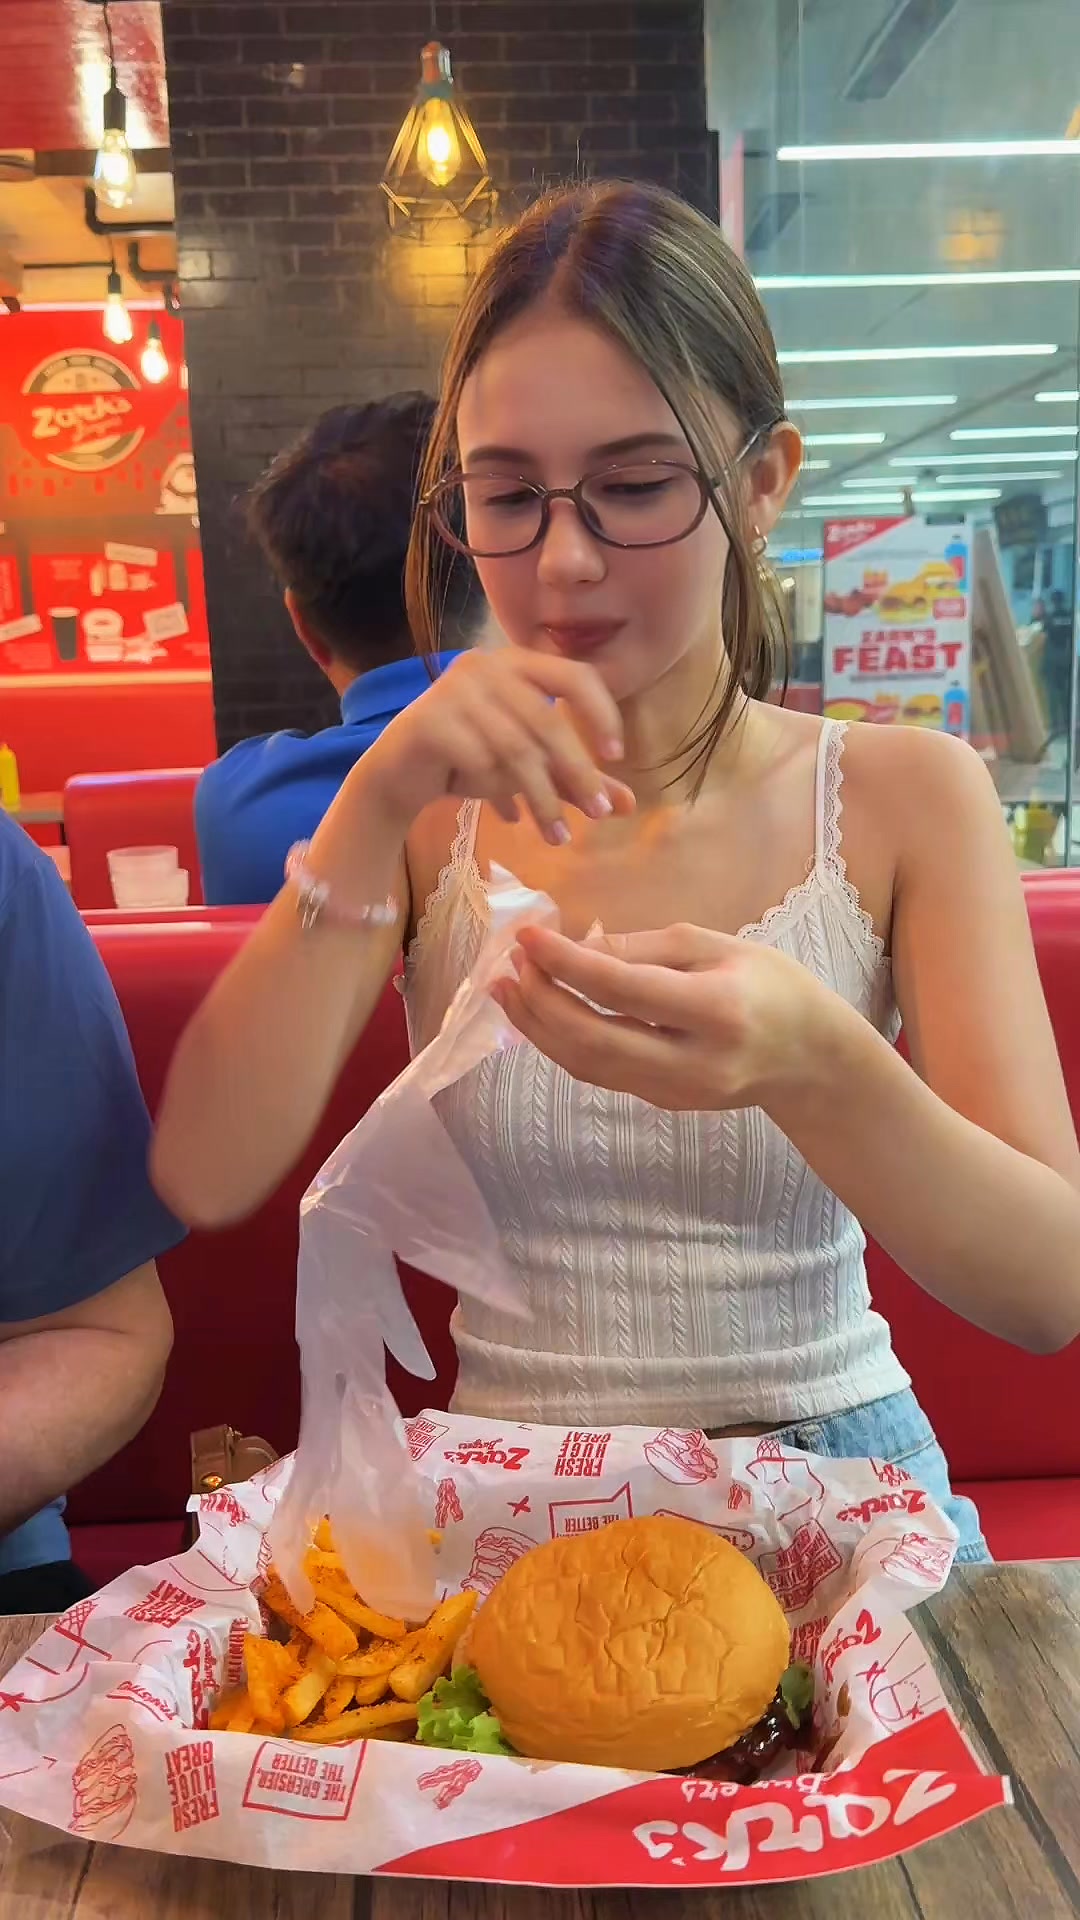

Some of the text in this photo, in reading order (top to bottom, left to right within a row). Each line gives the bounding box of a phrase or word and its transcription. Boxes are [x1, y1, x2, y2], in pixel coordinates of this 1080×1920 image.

[833, 642, 963, 674] FEAST
[558, 1442, 608, 1459] HUGE
[562, 1431, 612, 1443] GREAT
[444, 1447, 530, 1471] Zark's
[553, 1457, 603, 1477] FRESH
[564, 1515, 600, 1533] BETTER
[164, 1741, 214, 1780] GREAT
[271, 1753, 345, 1782] THE BETTER
[166, 1765, 217, 1806] HUGE
[256, 1767, 346, 1802] THE GREASIER,
[173, 1791, 220, 1833] FRESH
[633, 1769, 957, 1872] Zark's
